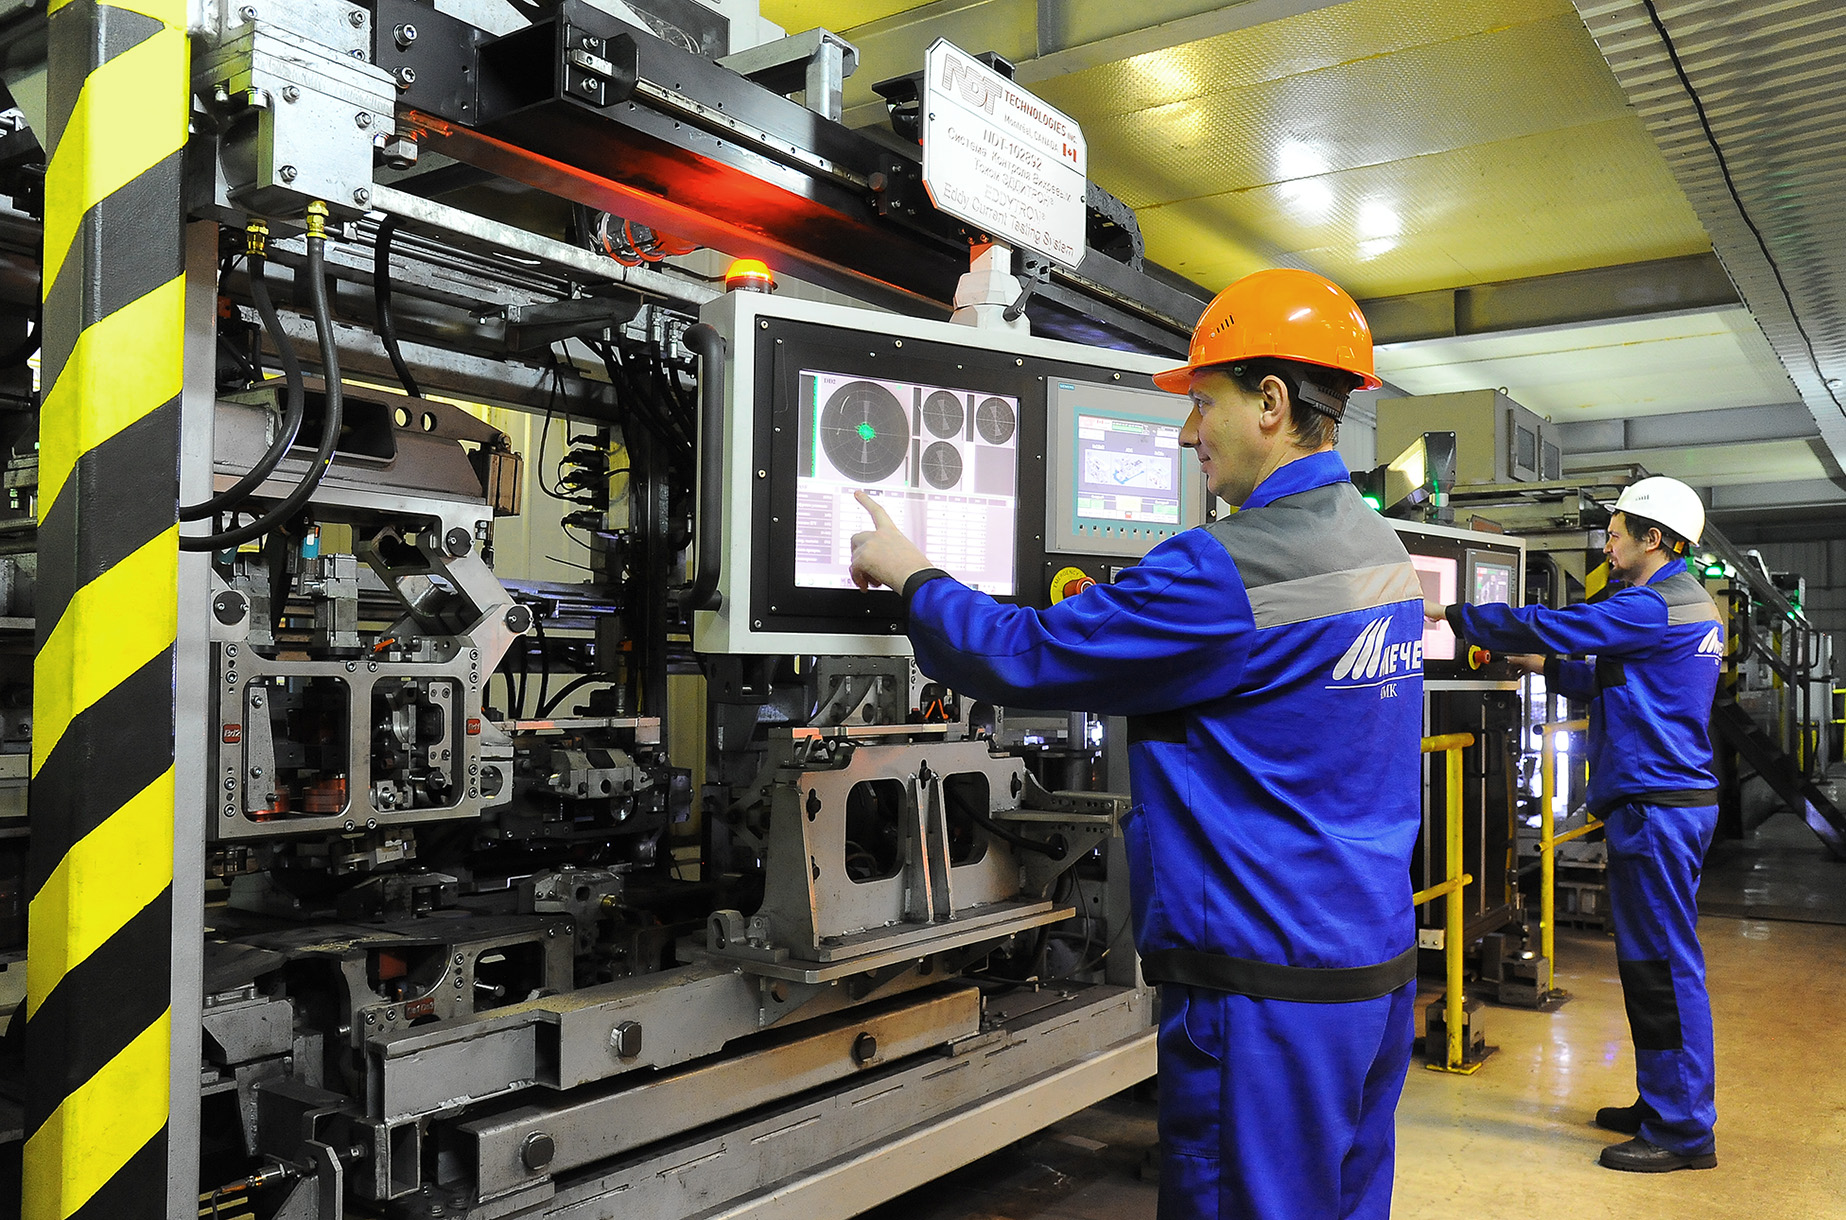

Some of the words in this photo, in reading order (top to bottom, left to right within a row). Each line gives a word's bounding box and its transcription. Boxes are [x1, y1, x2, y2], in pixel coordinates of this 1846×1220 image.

[941, 53, 1003, 115] NDT
[1004, 89, 1067, 137] TECHNOLOGIES
[947, 127, 987, 157] Система
[943, 182, 970, 210] Eddy
[972, 197, 1007, 226] Current
[1010, 215, 1041, 245] Testing
[1043, 231, 1075, 258] System
